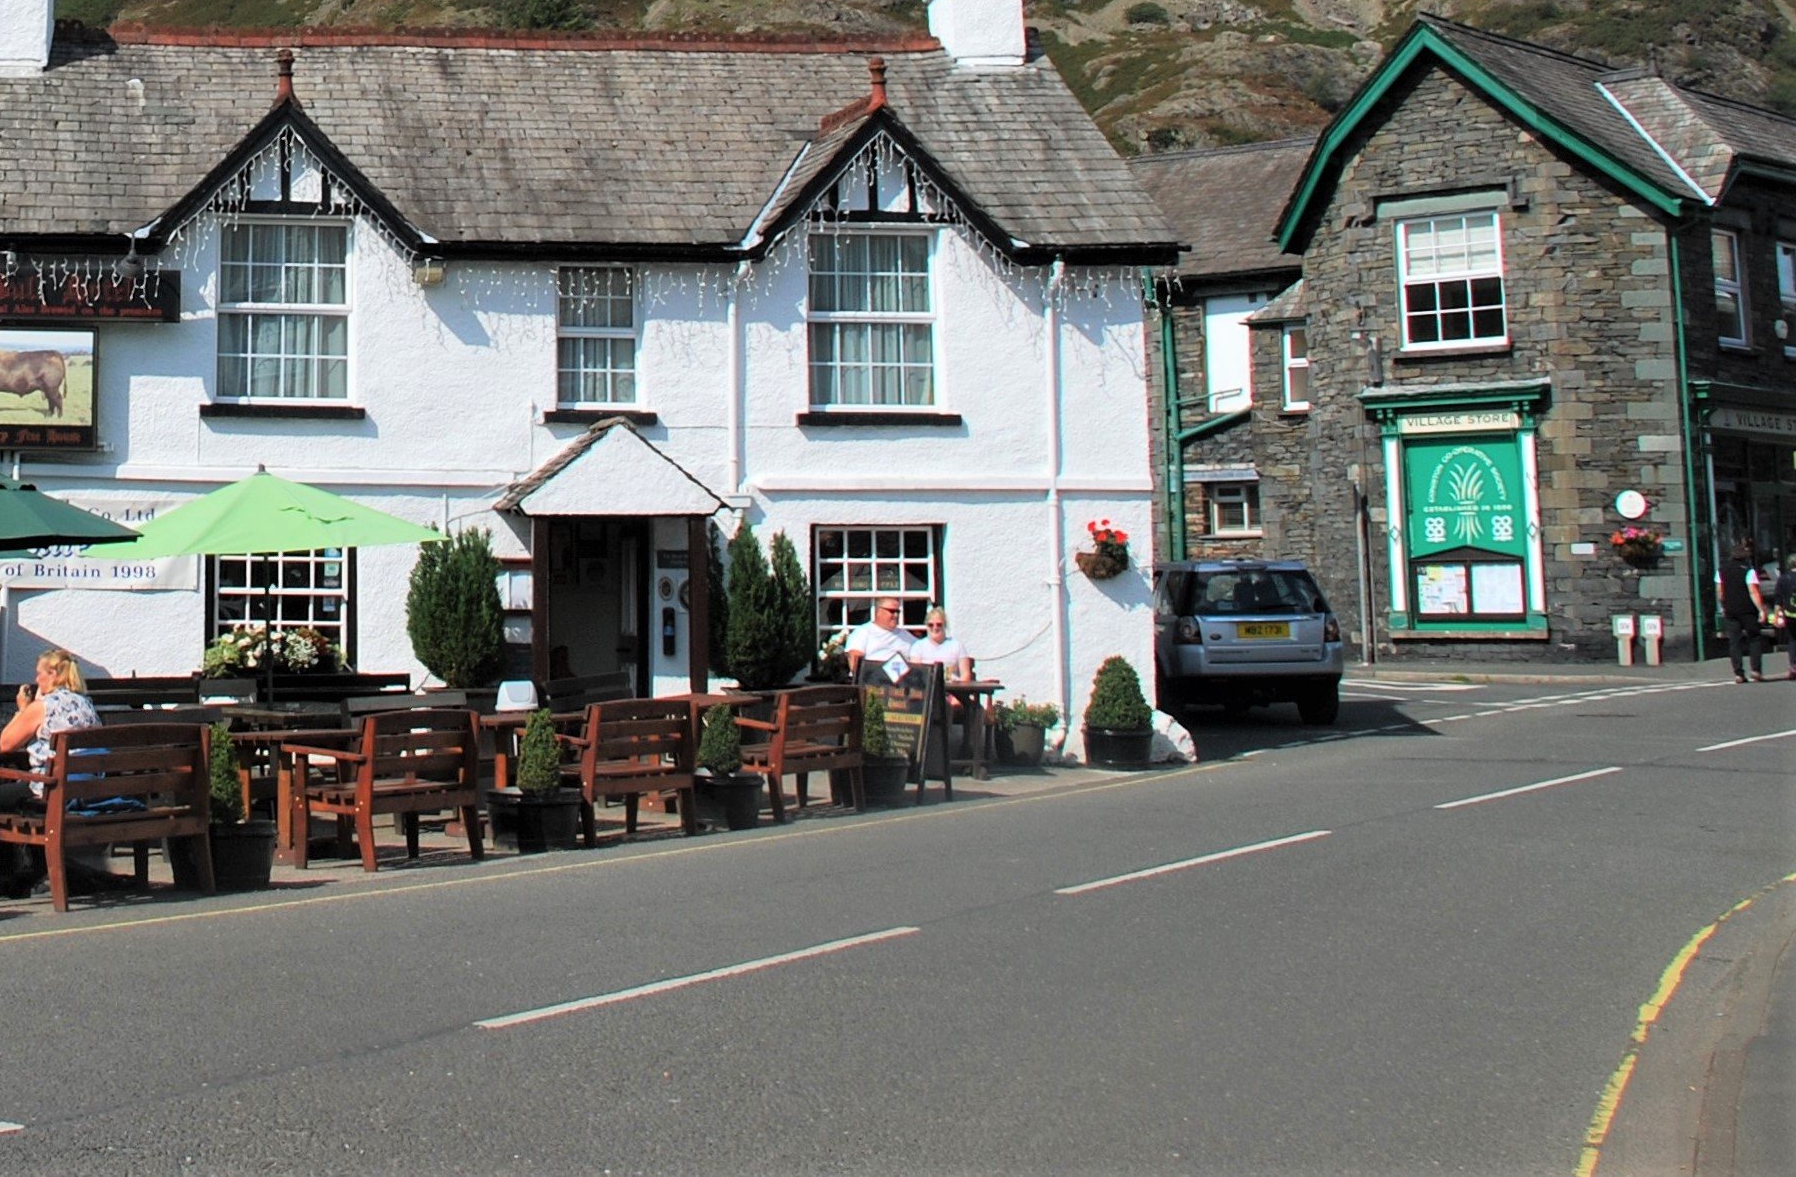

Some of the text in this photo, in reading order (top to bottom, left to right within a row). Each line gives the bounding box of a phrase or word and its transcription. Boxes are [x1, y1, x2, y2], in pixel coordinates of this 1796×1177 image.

[1406, 416, 1460, 427] VILLAGE
[1736, 413, 1781, 430] VILLAGE
[125, 508, 155, 521] Ltd
[5, 563, 24, 577] of
[35, 564, 101, 578] Britain
[111, 566, 155, 579] 1998
